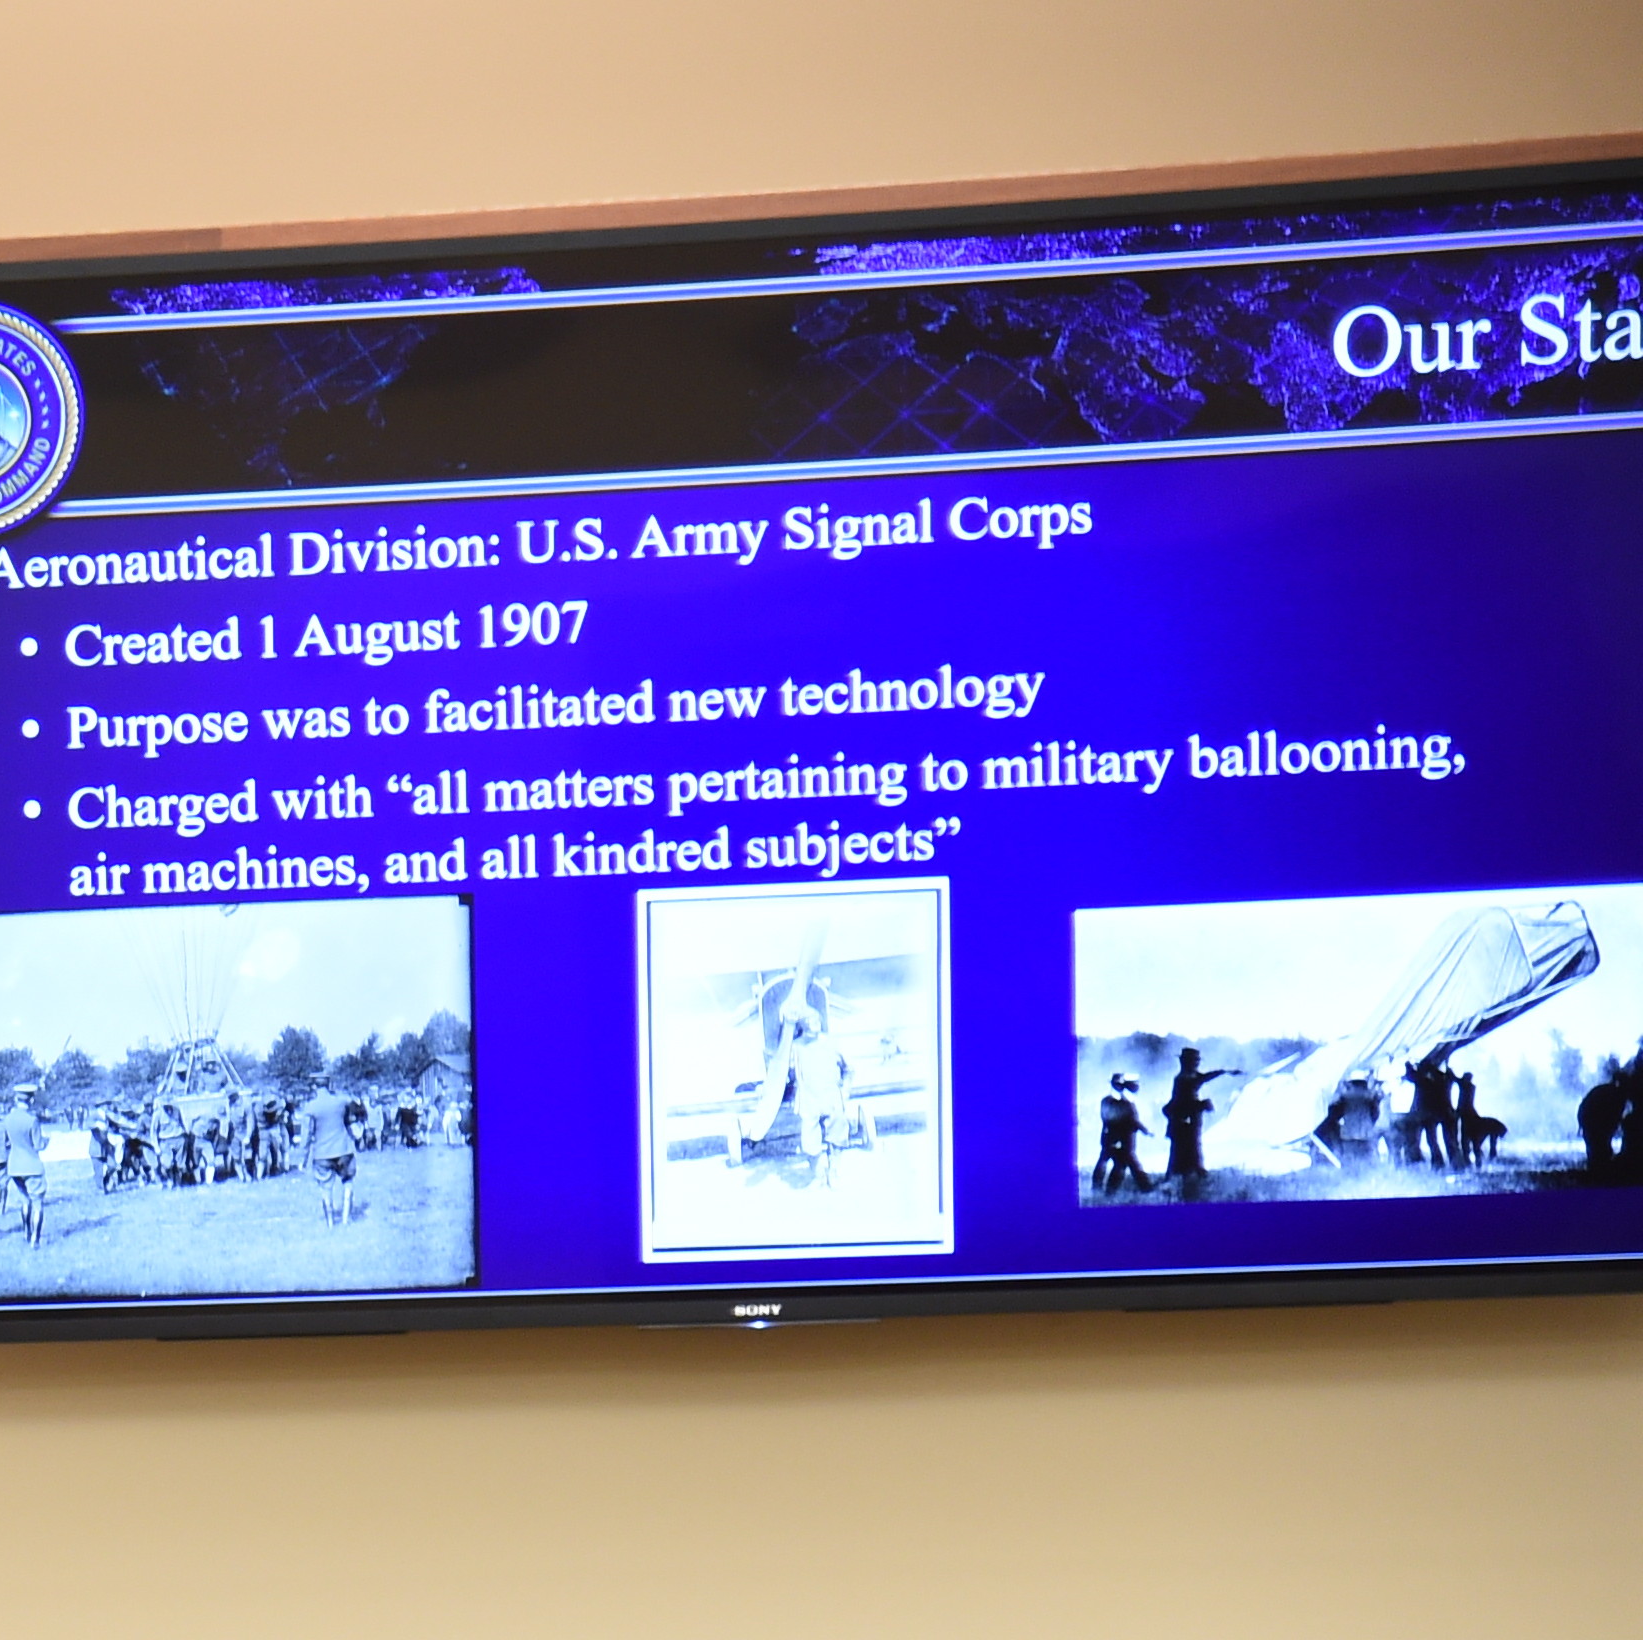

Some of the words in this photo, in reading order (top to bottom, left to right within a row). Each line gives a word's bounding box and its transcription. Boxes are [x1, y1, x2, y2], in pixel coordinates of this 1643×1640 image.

[1332, 304, 1493, 378] Our
[1519, 291, 1643, 367] Sta
[288, 524, 500, 576] Division:
[515, 517, 618, 564] U.S.
[630, 514, 770, 566] Army
[782, 497, 935, 561] Signal
[948, 496, 1093, 550] Corps
[64, 615, 243, 667] Created
[259, 614, 278, 659] 1
[293, 610, 461, 667] August
[478, 599, 589, 649] 1907
[66, 705, 249, 759] Purpose
[260, 706, 351, 740] was
[363, 696, 410, 736] to
[423, 678, 656, 734] facilitated
[668, 686, 768, 723] new
[779, 663, 1046, 720] technology
[67, 777, 260, 838] Charged
[271, 773, 375, 821] with
[386, 768, 471, 816] “all
[483, 768, 655, 813] matters
[667, 751, 908, 817] pertaining
[919, 752, 969, 792] to
[981, 739, 1175, 795] military
[1187, 723, 1466, 781] ballooning,
[69, 851, 131, 897] air
[141, 844, 370, 894] machines,
[384, 836, 469, 885] and
[480, 833, 540, 880] all
[552, 824, 733, 878] kindred
[745, 816, 962, 878] subjects”
[734, 1303, 782, 1317] SONY
